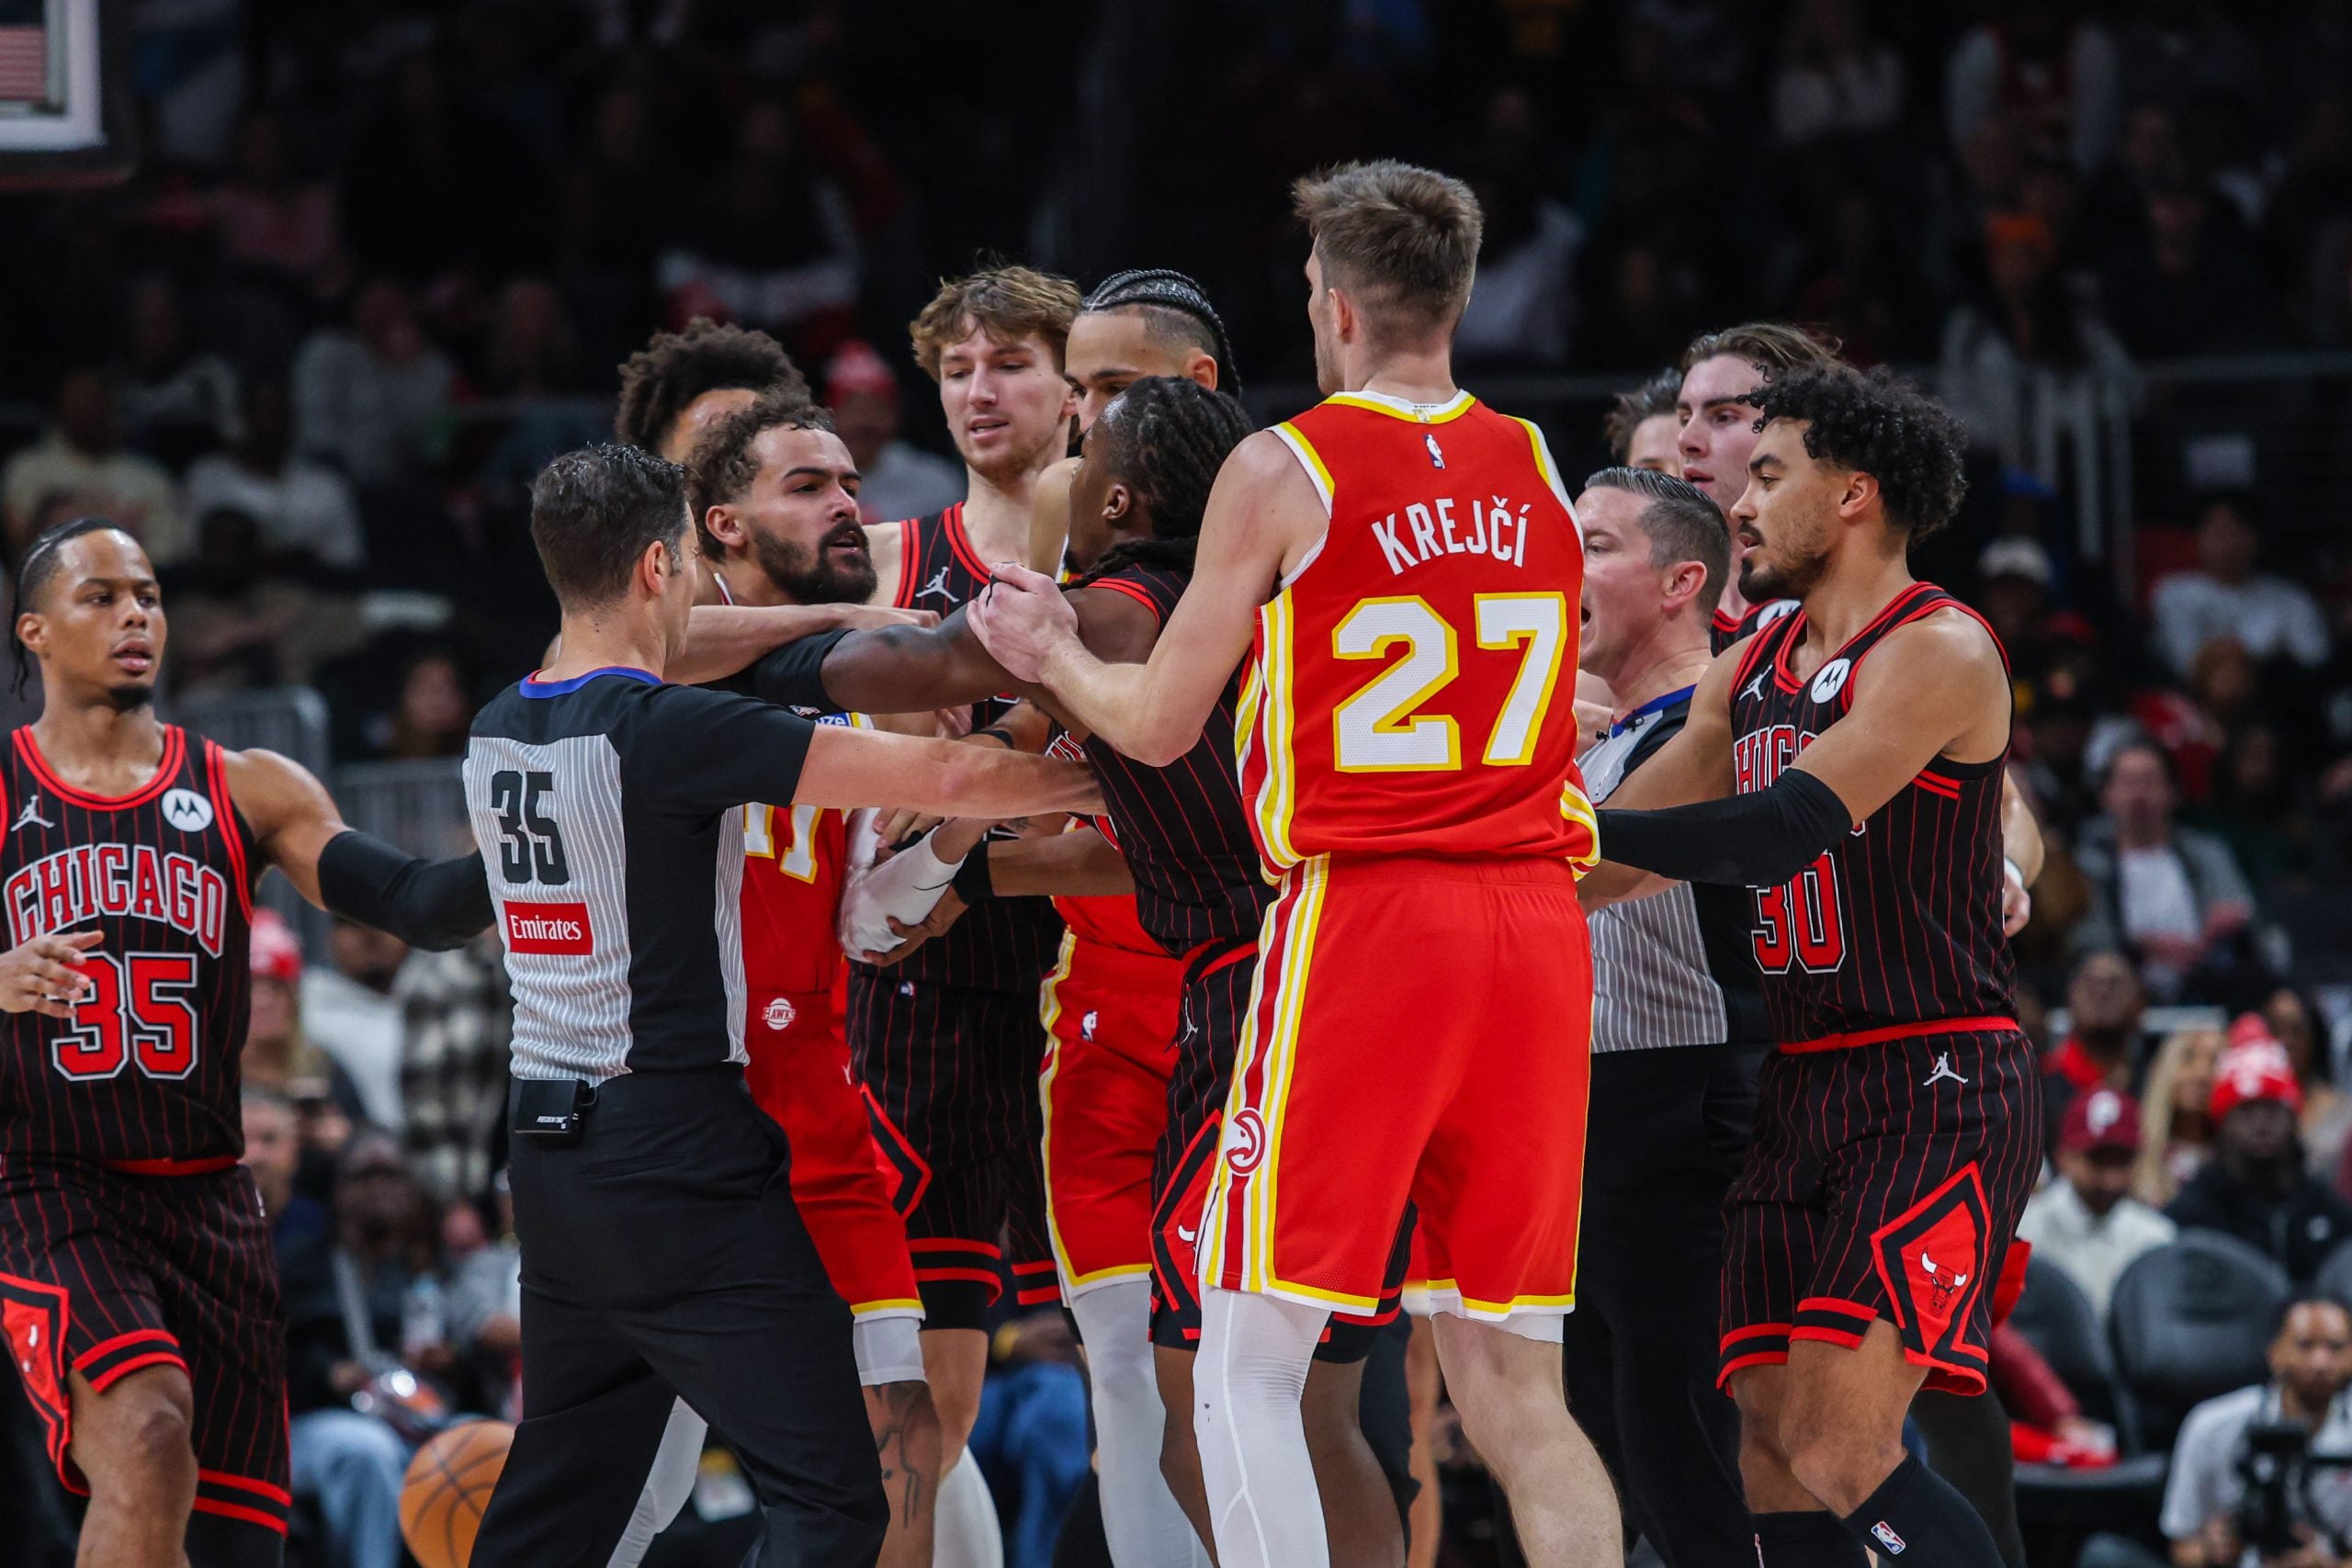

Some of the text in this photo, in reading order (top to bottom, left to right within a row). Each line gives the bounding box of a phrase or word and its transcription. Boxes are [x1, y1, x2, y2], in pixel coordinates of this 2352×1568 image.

[1371, 494, 1532, 576] KREJČÍ
[1331, 591, 1567, 773] 27
[491, 770, 571, 886] 35
[3, 842, 227, 959] CHICAGO
[509, 914, 582, 941] Emirates
[1751, 848, 1847, 975] 30
[47, 951, 198, 1082] 35
